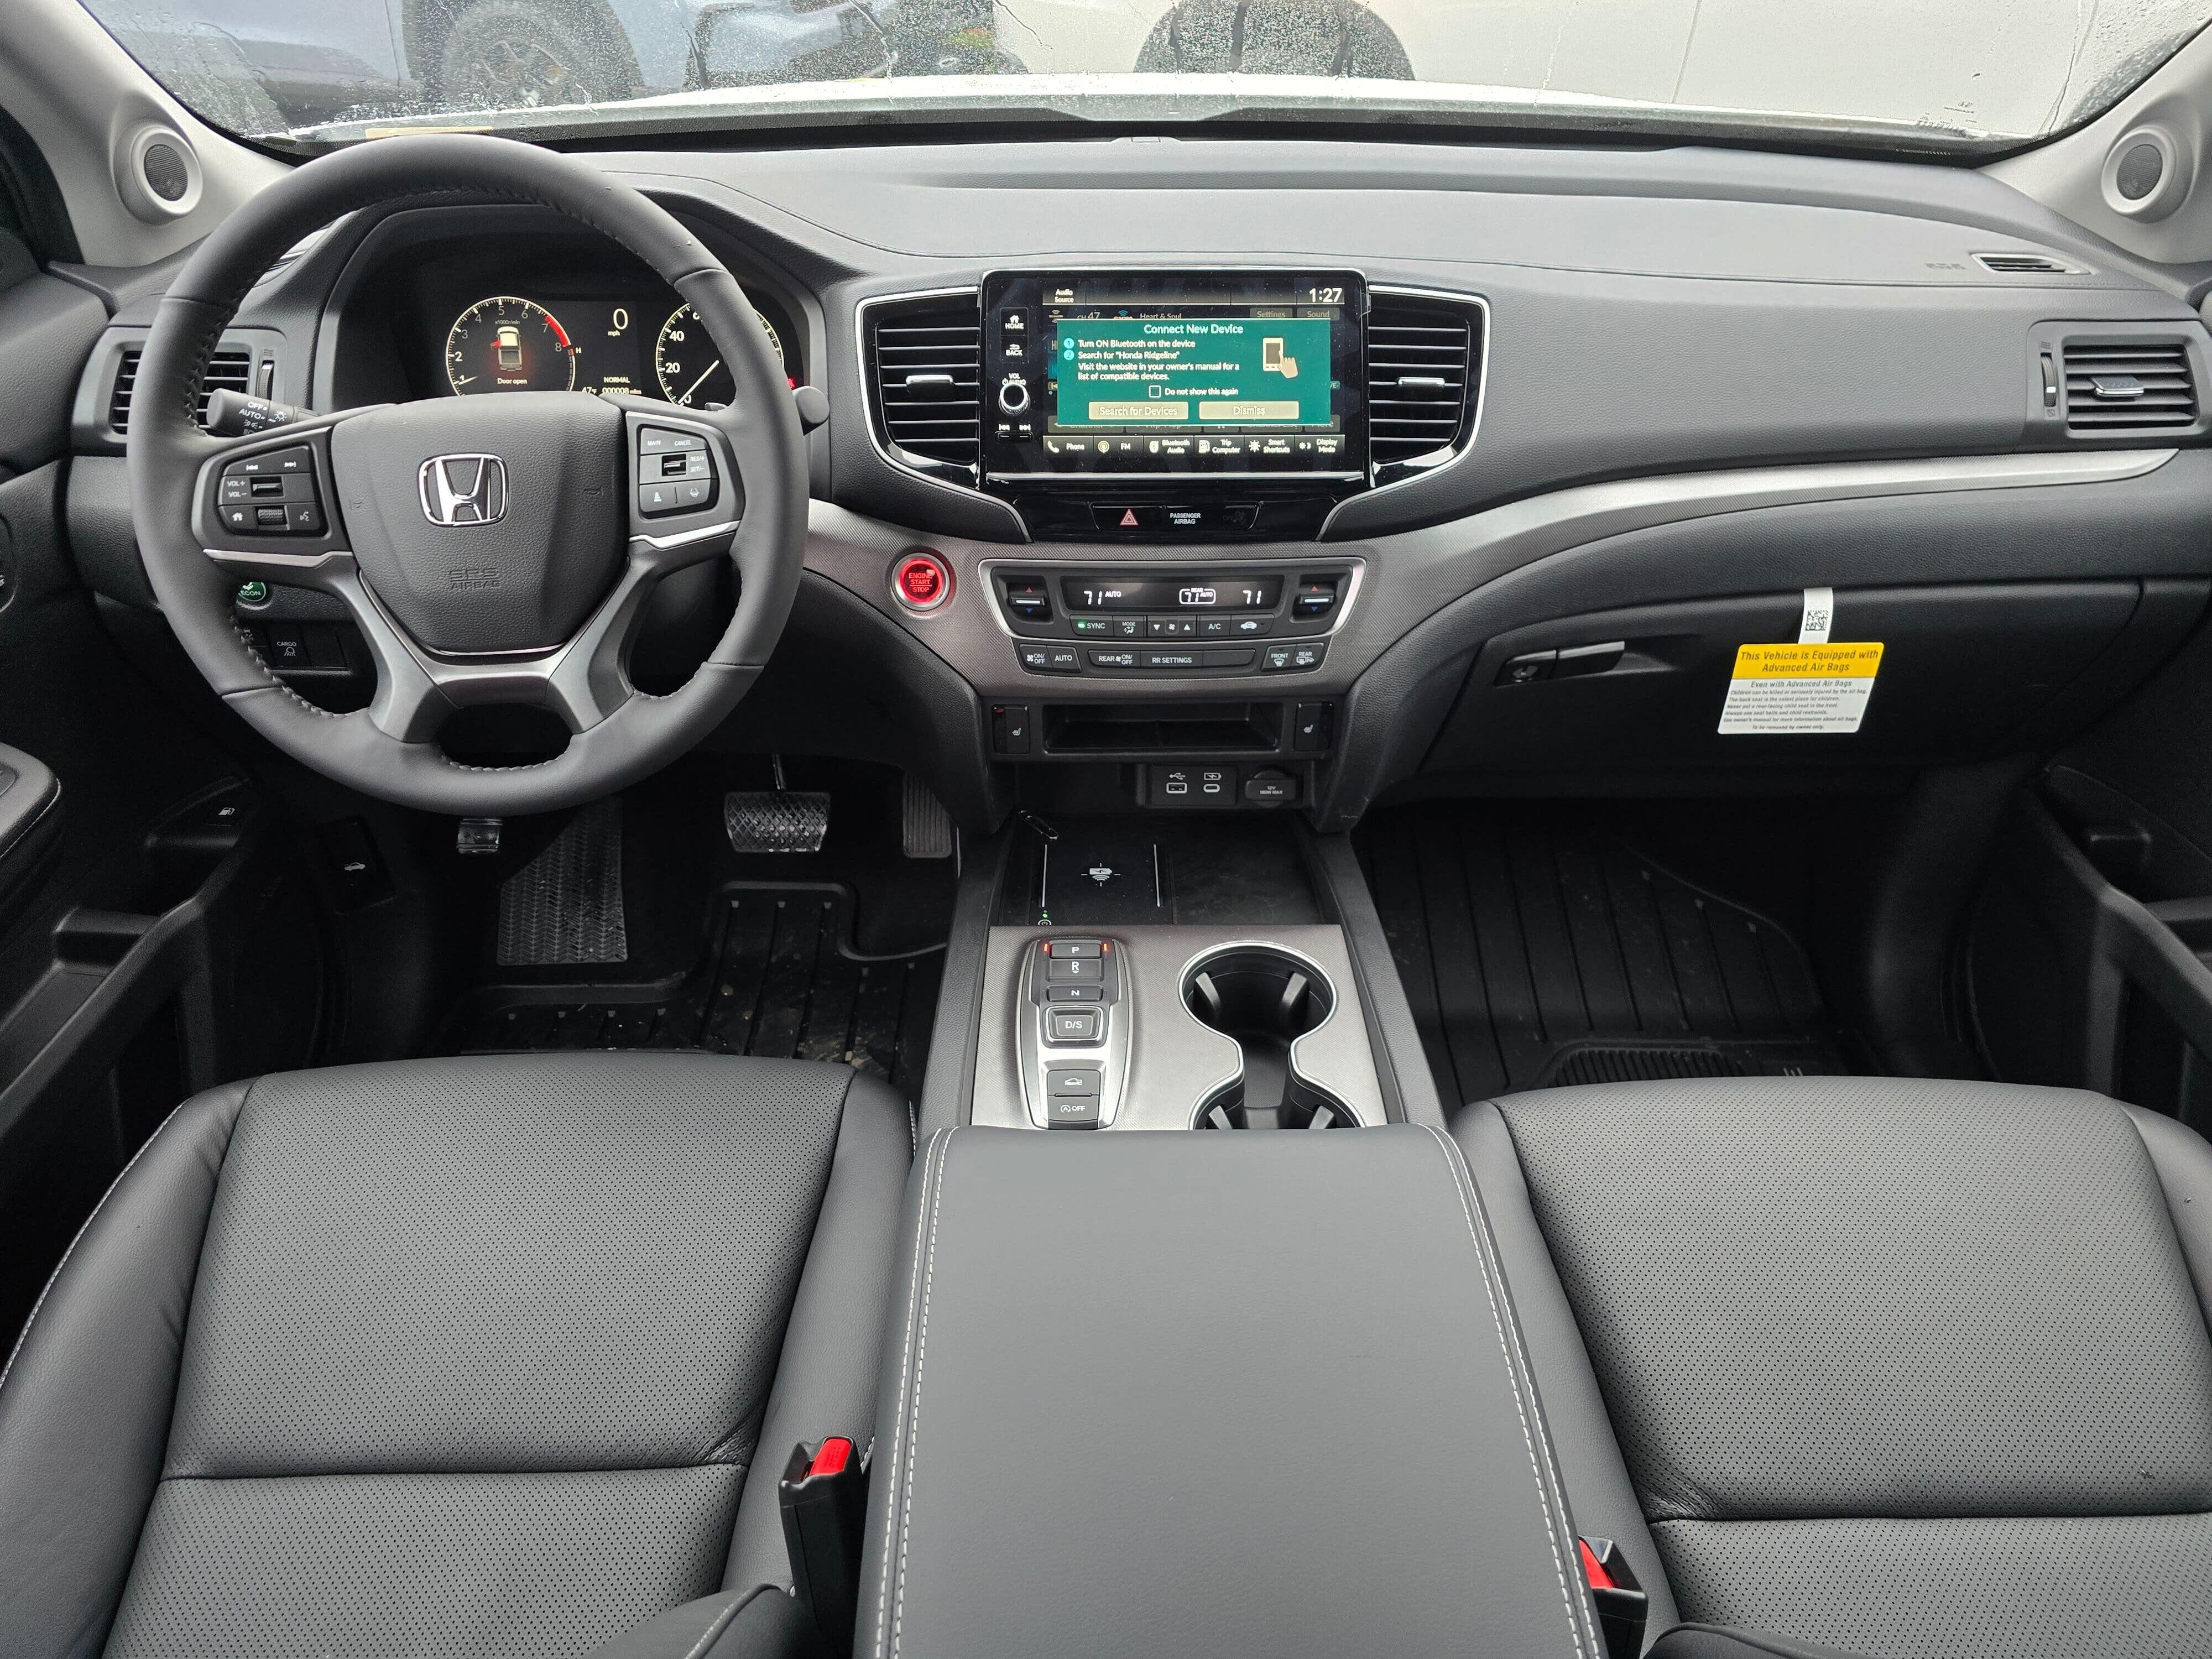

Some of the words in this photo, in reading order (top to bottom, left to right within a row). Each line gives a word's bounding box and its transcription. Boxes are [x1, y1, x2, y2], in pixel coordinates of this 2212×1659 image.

[1309, 288, 1343, 302] 1:27
[498, 306, 505, 315] 5
[521, 310, 529, 319] 6
[475, 314, 482, 323] 4
[613, 308, 628, 330] 0
[542, 324, 549, 333] 7
[1144, 324, 1184, 334] Connect
[1186, 324, 1208, 333] New
[1211, 324, 1244, 334] Device
[462, 330, 468, 338] 3
[669, 331, 685, 342] 40
[555, 342, 562, 352] 8
[1095, 340, 1109, 348] ON
[1110, 340, 1146, 348] Bluetooth
[1158, 340, 1170, 348] the
[1171, 340, 1196, 348] device
[455, 352, 463, 362] 2
[1144, 351, 1180, 360] Ridgeline"
[665, 362, 681, 373] 20
[1147, 364, 1165, 372] your
[1099, 373, 1139, 381] compatible
[1221, 388, 1239, 396] again
[248, 401, 263, 410] OFF
[239, 409, 262, 419] AUTO
[1099, 406, 1128, 415] Search
[1130, 406, 1142, 415] for
[1144, 406, 1178, 415] Devices
[1233, 406, 1266, 415] Dismiss
[1084, 591, 1102, 605] 71
[1185, 592, 1199, 602] 71
[1243, 590, 1261, 604] 71
[1741, 651, 1760, 661] This
[1764, 651, 1798, 660] Vehicle
[1801, 651, 1809, 660] is
[1812, 650, 1856, 661] Equipped
[1859, 649, 1879, 659] with
[1762, 664, 1807, 672] Advanced
[1809, 663, 1824, 672] Air
[1827, 662, 1850, 673] Bags
[1072, 962, 1079, 970] R
[1065, 1020, 1083, 1029] D/S
